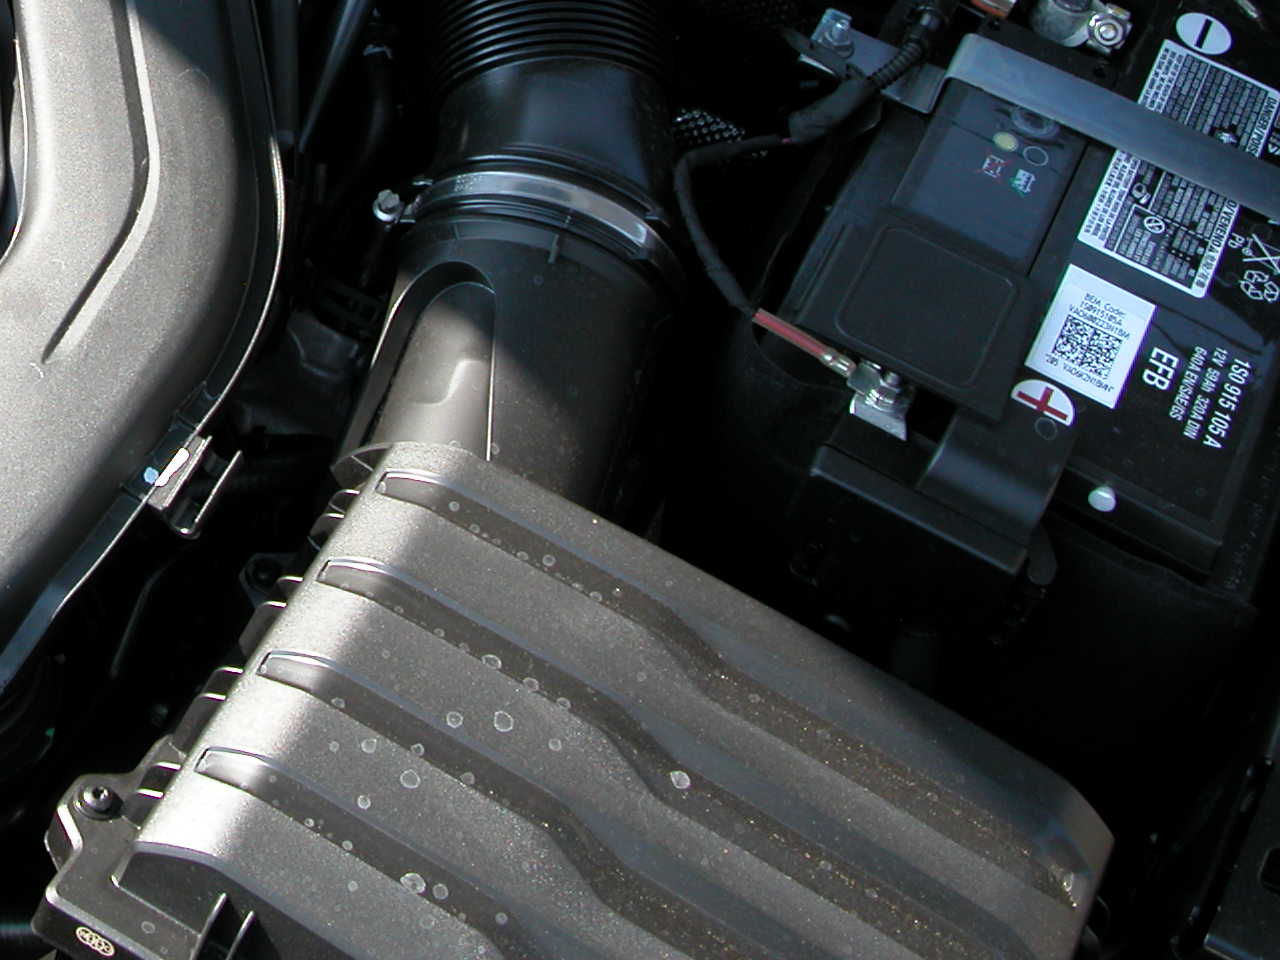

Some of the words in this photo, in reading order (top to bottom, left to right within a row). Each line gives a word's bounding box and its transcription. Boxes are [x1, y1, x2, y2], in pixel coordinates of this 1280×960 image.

[1228, 232, 1245, 248] Pb
[1142, 346, 1179, 390] EFB
[1187, 346, 1207, 371] 640A
[1212, 347, 1228, 367] 12V
[1190, 394, 1209, 420] 320A
[1218, 383, 1241, 411] 915
[1183, 420, 1200, 439] DIN
[1208, 410, 1232, 437] 105
[1202, 434, 1222, 448] A
